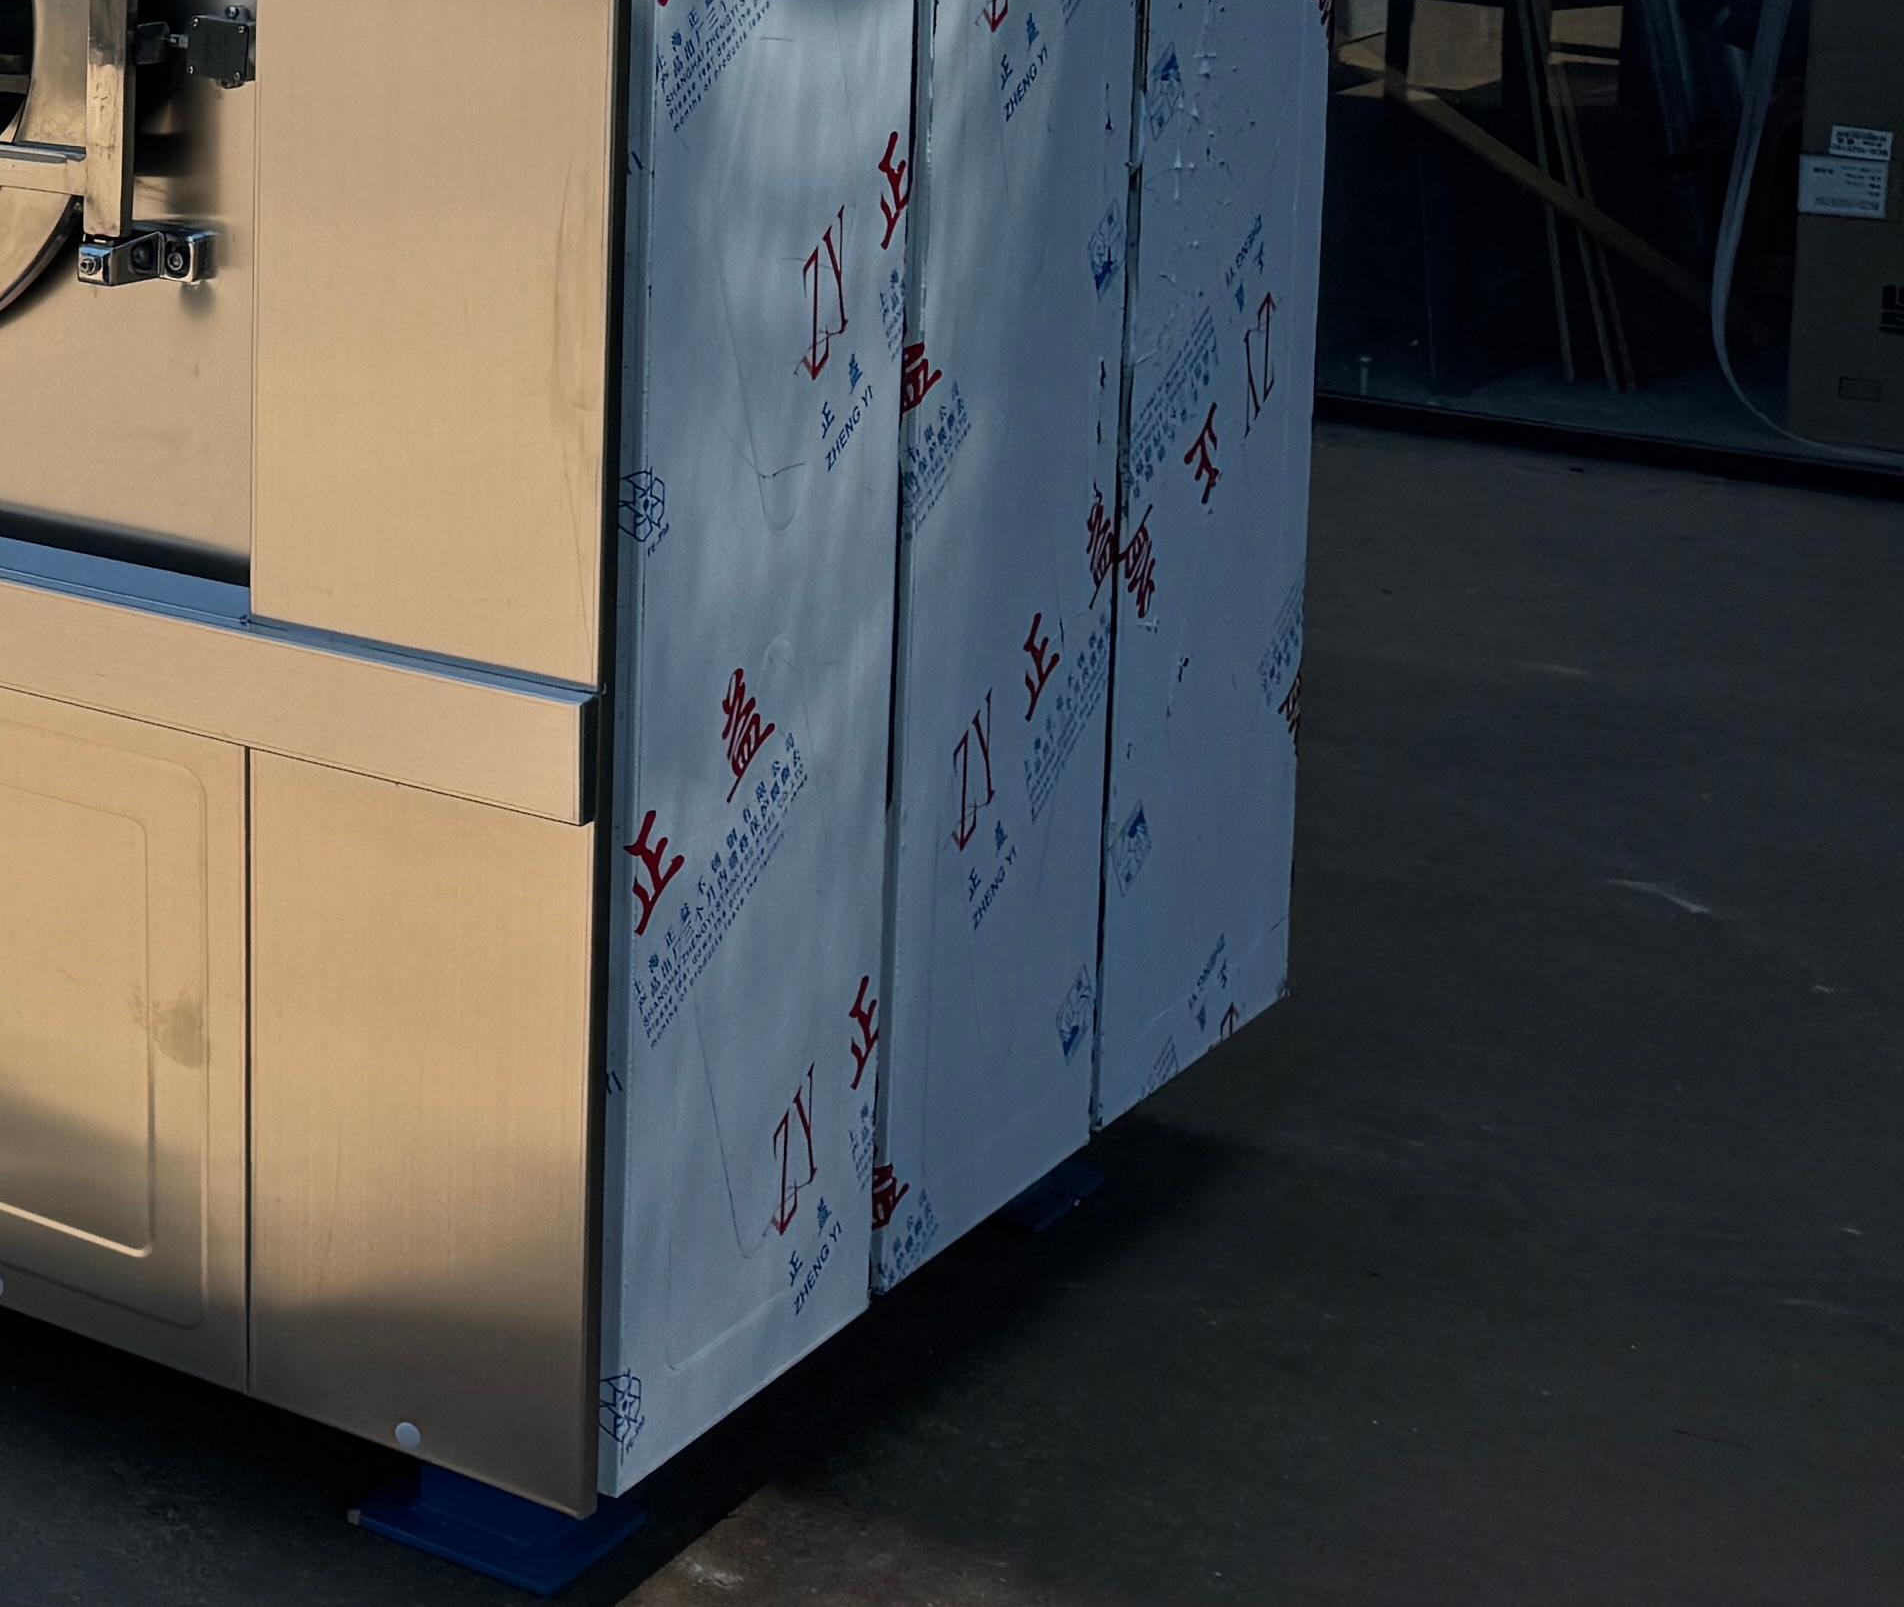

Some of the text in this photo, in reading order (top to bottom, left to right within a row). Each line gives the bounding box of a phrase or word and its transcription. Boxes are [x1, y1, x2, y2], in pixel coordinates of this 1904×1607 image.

[1004, 44, 1050, 123] ZHENG YI
[826, 384, 875, 472] ZHENG YI
[794, 1220, 844, 1315] ZHENG YI
